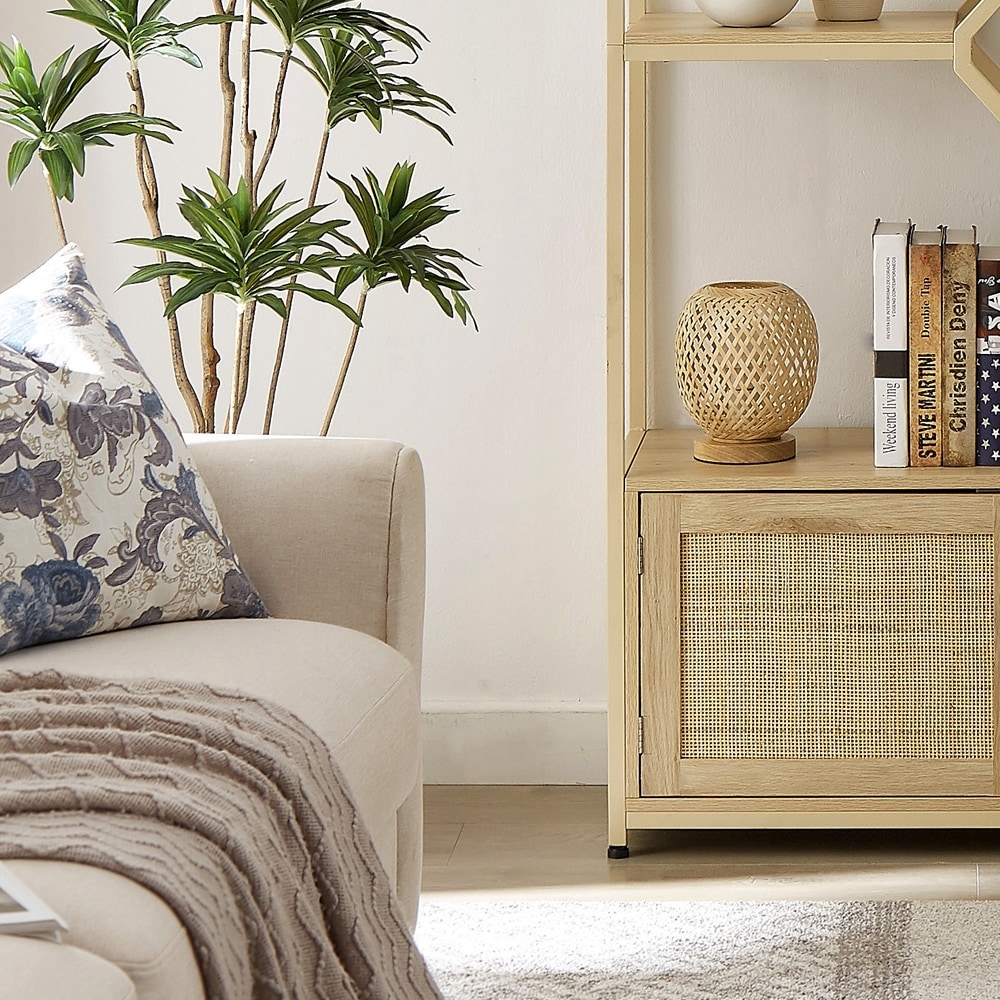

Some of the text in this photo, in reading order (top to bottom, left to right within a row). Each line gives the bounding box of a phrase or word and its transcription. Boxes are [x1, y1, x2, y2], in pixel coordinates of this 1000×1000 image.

[920, 278, 932, 297] Tap
[949, 280, 970, 432] Chrisdien Deny
[882, 382, 900, 454] Weekend living
[918, 354, 937, 459] STEVE MARTINI
